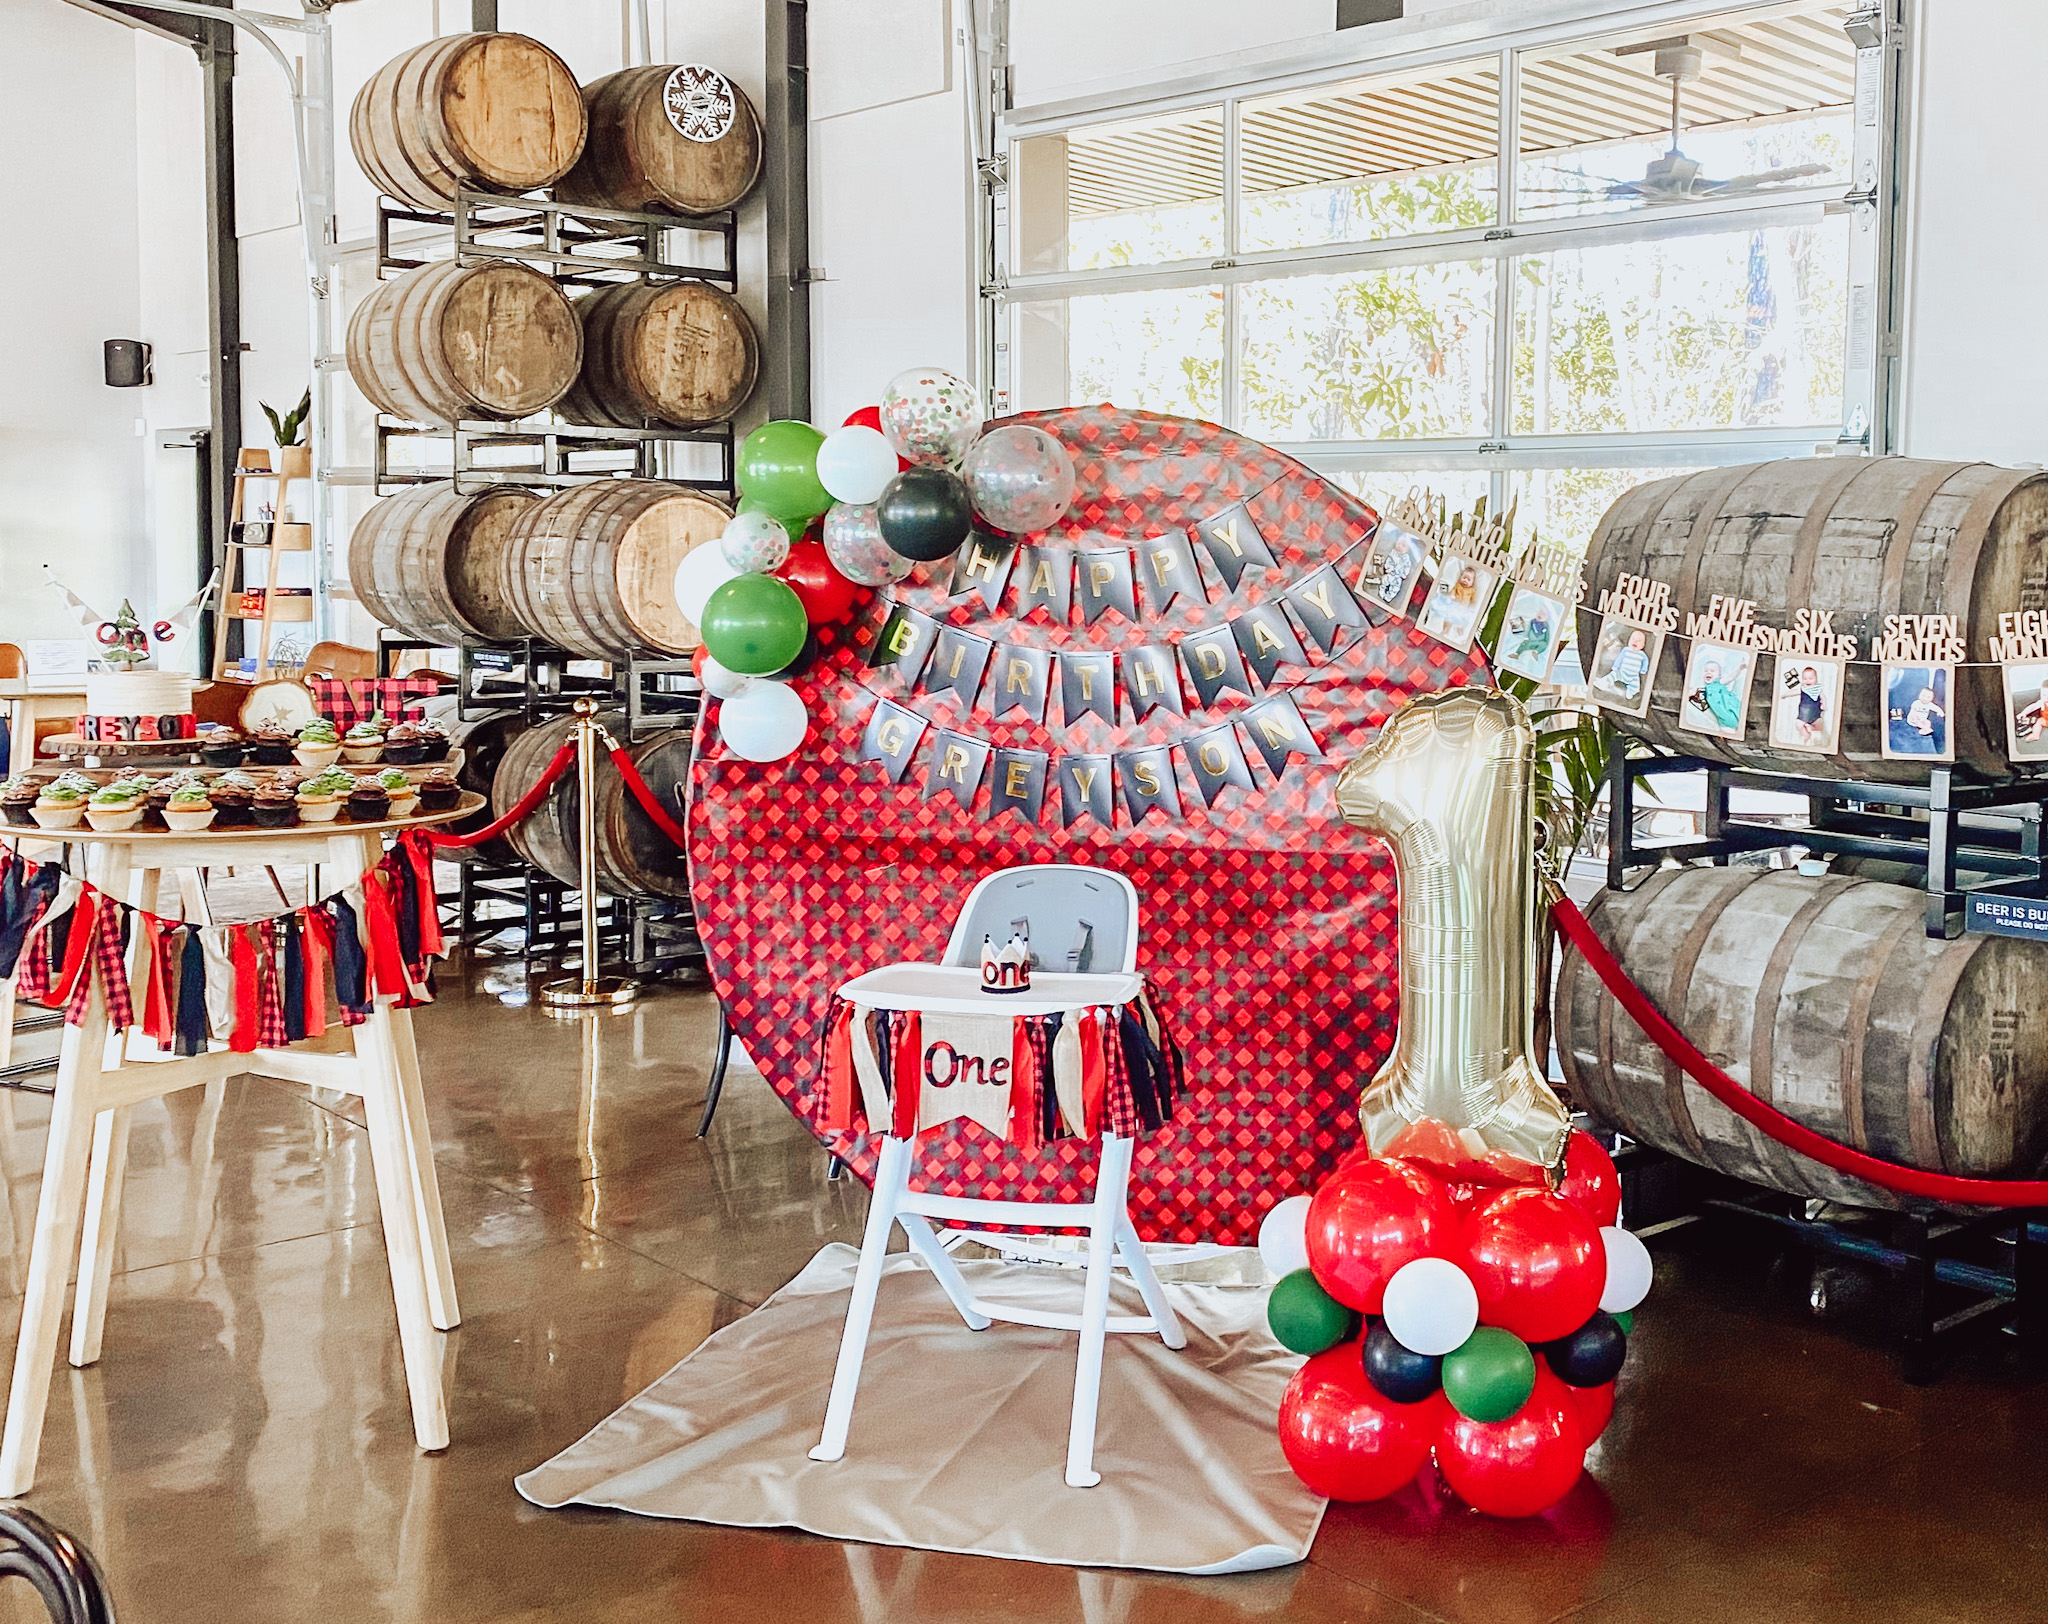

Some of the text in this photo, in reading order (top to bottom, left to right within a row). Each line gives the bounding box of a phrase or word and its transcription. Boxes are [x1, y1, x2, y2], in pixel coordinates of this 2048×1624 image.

[1467, 512, 1506, 549] TWO
[965, 518, 1244, 598] HAPPY
[1438, 522, 1513, 576] MONTHS
[1510, 556, 1589, 604] MONTHS
[1615, 571, 1671, 607] FOUR
[1598, 588, 1680, 632] MONTHS
[1708, 594, 1757, 626] FIVE
[1794, 607, 1834, 635] SIX
[1883, 614, 1958, 639] SEVEN
[888, 580, 1338, 701] BIRTHDAY
[1685, 611, 1769, 651] MONTHS
[1768, 626, 1858, 660] MONTHS
[1871, 635, 1966, 663] MONTHS
[876, 703, 1298, 804] GREYSON
[1976, 902, 2048, 922] BEER IS BU
[1995, 917, 2023, 928] PLEASE
[2022, 921, 2034, 930] DO
[983, 959, 1031, 987] one
[924, 1040, 1011, 1089] One
